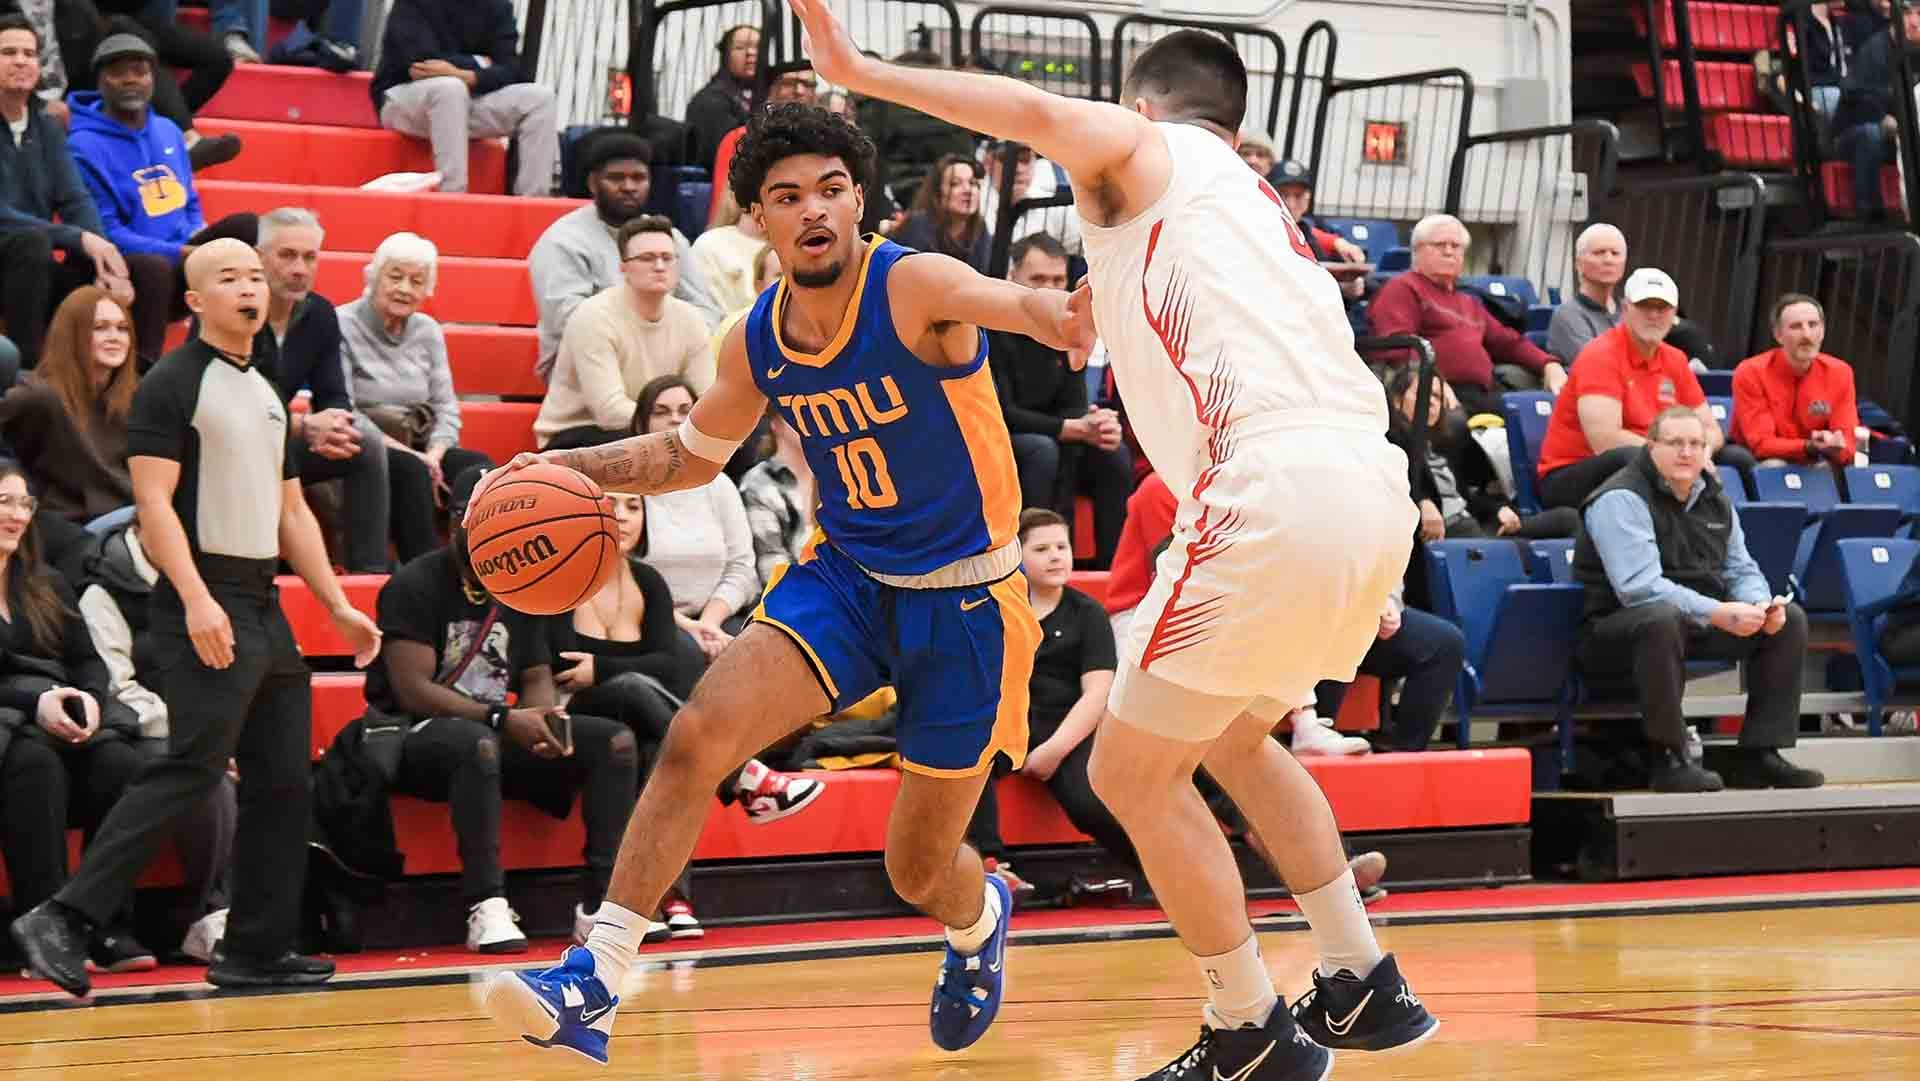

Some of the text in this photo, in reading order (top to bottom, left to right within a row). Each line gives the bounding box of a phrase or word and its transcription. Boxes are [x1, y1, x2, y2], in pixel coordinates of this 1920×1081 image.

[777, 375, 908, 437] TMU
[831, 437, 898, 510] 10
[472, 497, 537, 530] EVOLUT
[475, 534, 558, 577] Wilson
